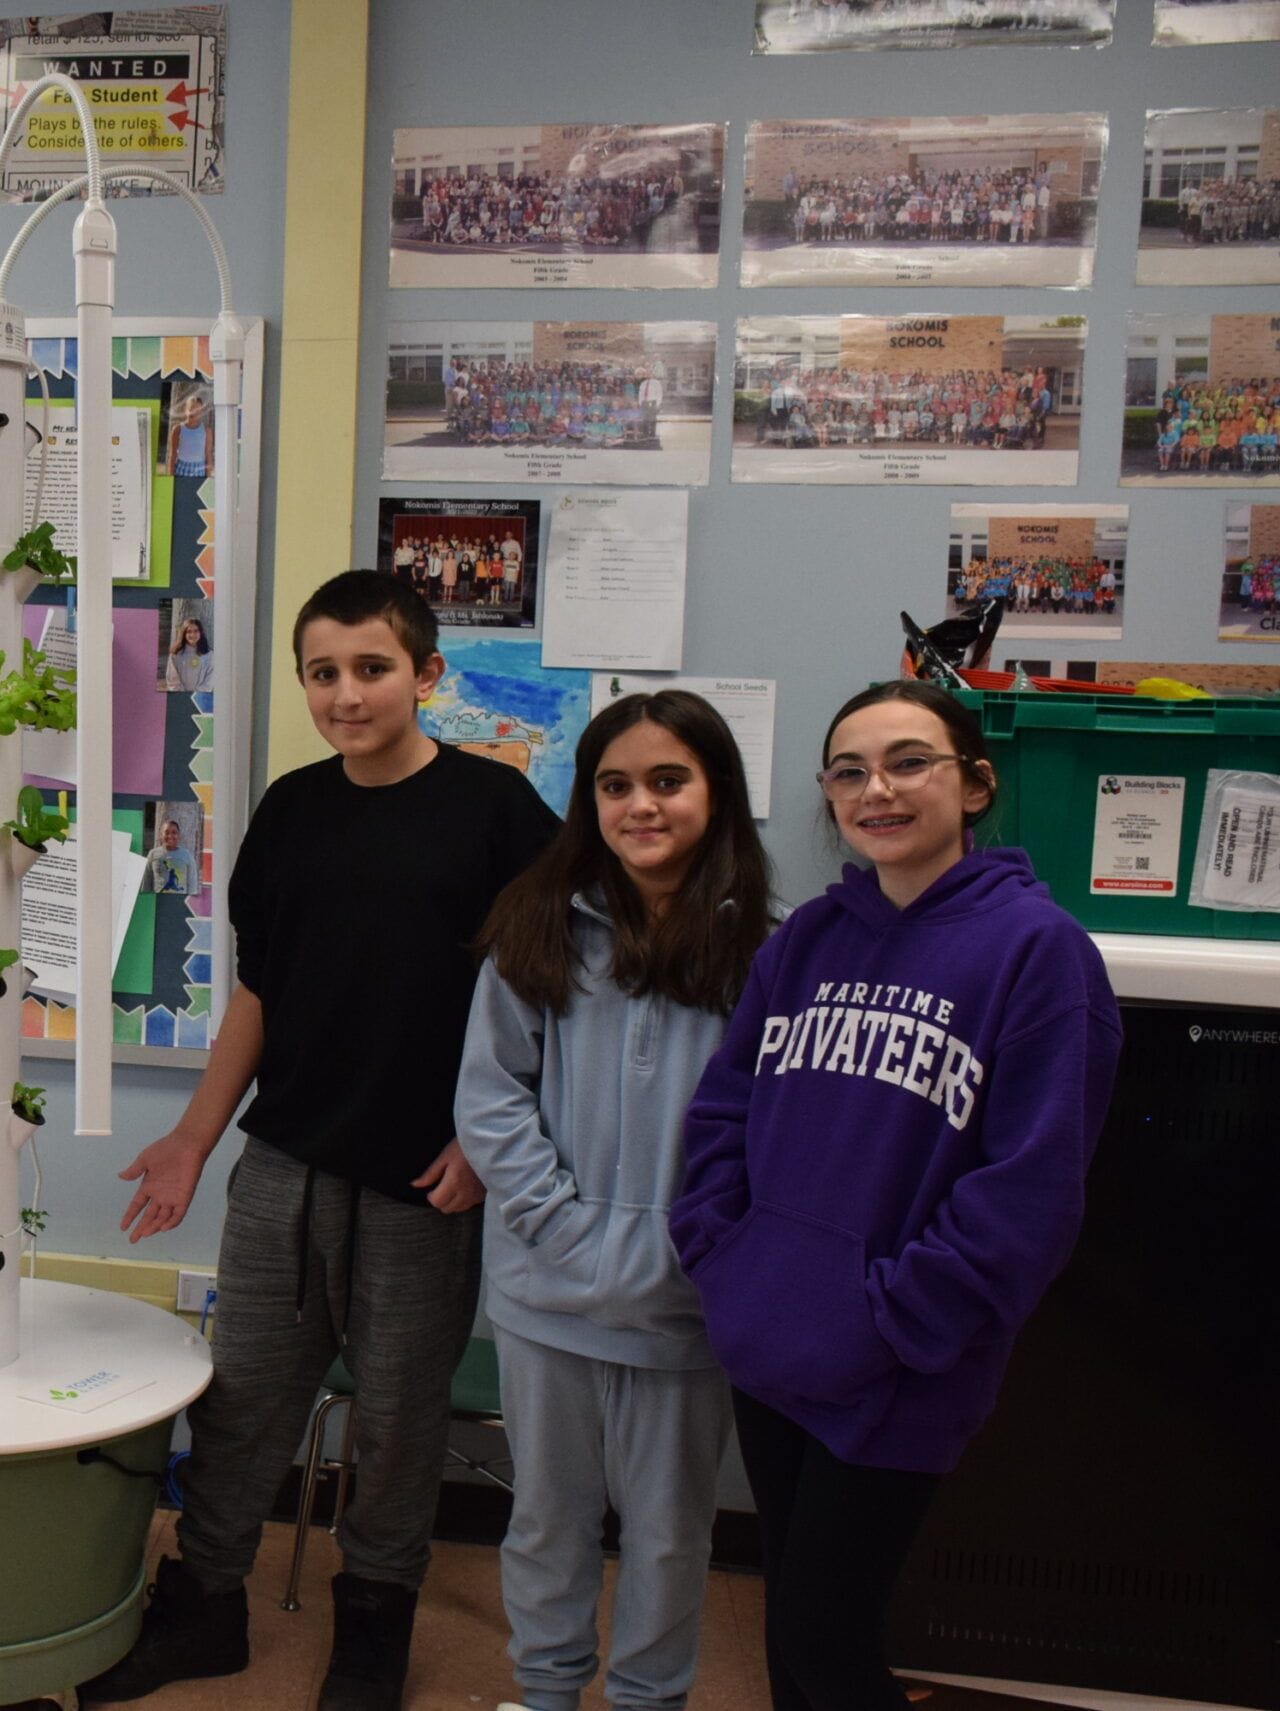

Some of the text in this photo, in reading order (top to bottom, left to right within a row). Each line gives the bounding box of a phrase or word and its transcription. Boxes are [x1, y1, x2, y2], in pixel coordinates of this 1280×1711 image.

[43, 60, 167, 77] WANTED
[91, 87, 159, 103] Student
[28, 117, 67, 134] Plays
[93, 117, 116, 131] the
[121, 116, 161, 132] rules.
[27, 134, 189, 151] Considete of others.
[889, 336, 946, 348] SCHOOL
[404, 501, 520, 512] Nokomis Elementary School
[1124, 780, 1182, 790] Building Blocks
[1213, 812, 1229, 871] IMMEDIATELY!
[1223, 807, 1241, 877] OPEN AND READ
[1102, 880, 1164, 890] www.carolina.com
[813, 981, 955, 1026] MARITIME
